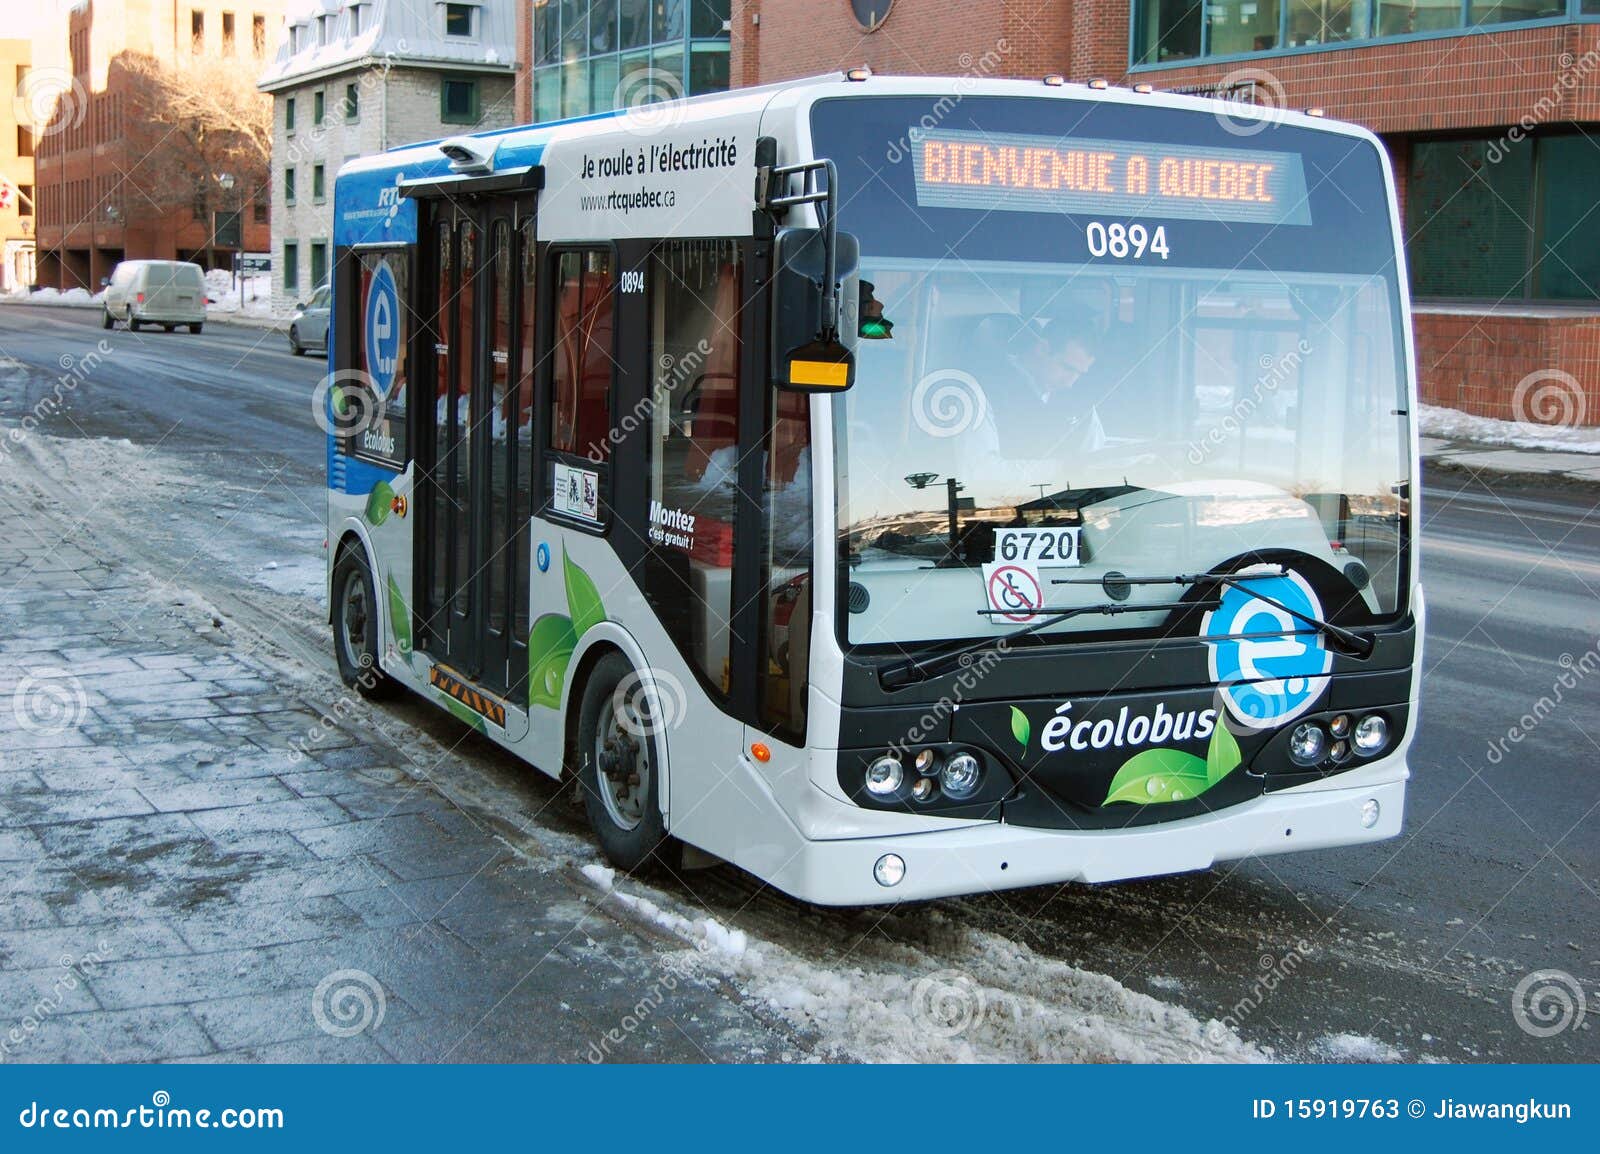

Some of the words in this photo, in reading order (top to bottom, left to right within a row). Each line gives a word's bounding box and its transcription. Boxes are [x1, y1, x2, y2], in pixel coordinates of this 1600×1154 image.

[580, 154, 595, 179] Je
[598, 148, 633, 177] roule
[636, 147, 646, 174] à
[649, 135, 738, 173] l'électricité
[923, 142, 1114, 194] BIENVENUE
[1126, 152, 1148, 196] A
[1158, 157, 1274, 202] QUEBEC
[580, 186, 676, 215] www.rtcquebec.ca
[1085, 221, 1170, 260] 0894
[620, 271, 645, 294] 0894
[649, 500, 695, 532] Montez
[648, 526, 664, 540] c'est
[664, 533, 689, 548] gratuit
[1001, 531, 1073, 561] 6720
[1041, 701, 1216, 752] écolobus
